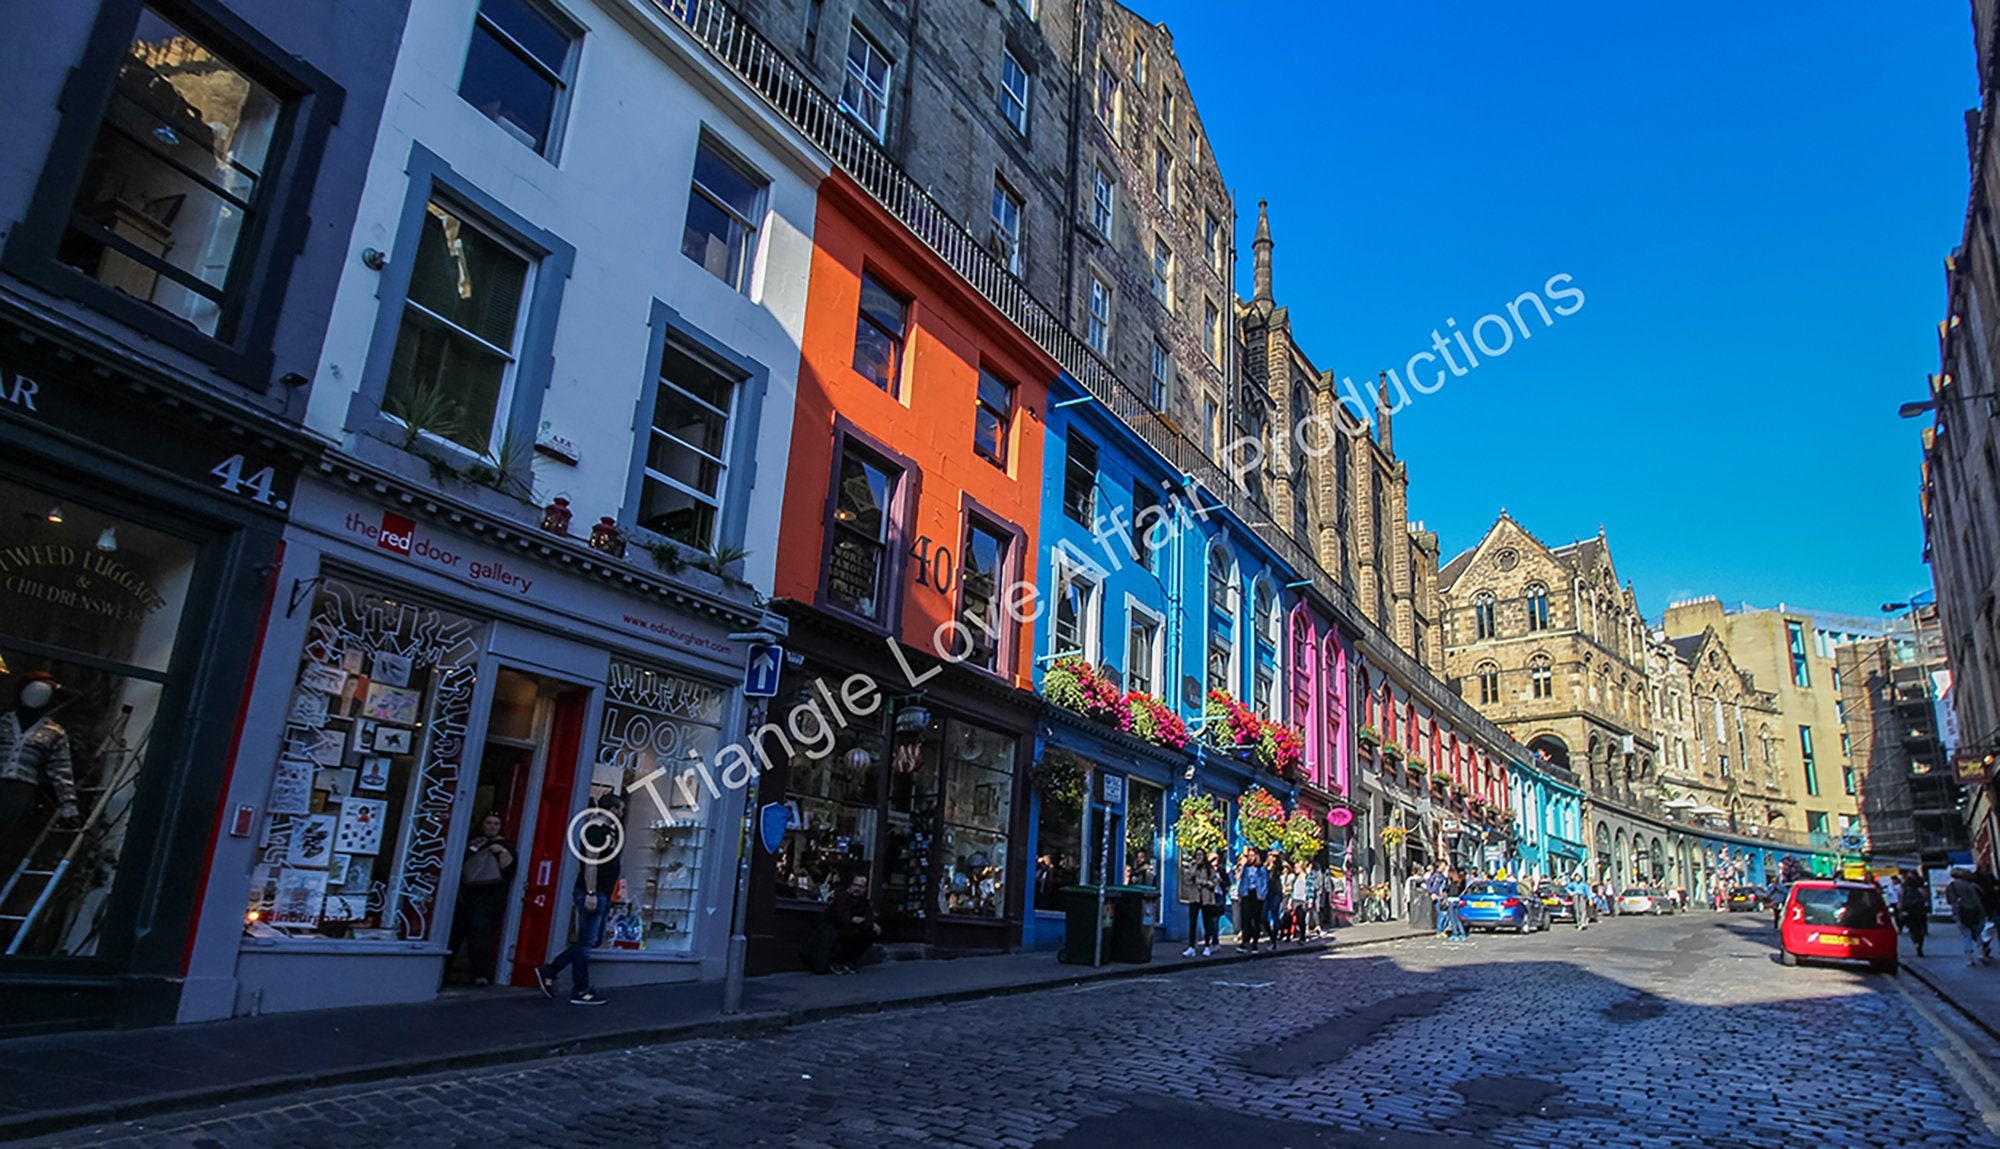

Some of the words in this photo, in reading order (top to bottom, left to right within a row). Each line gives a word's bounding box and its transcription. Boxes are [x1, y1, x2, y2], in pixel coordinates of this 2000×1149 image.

[345, 512, 379, 539] the
[379, 530, 413, 551] red
[414, 537, 462, 567] door
[468, 560, 533, 595] gallery
[908, 535, 952, 596] 40
[622, 613, 732, 655] www.edinburghart.com
[600, 707, 705, 760] LOOK
